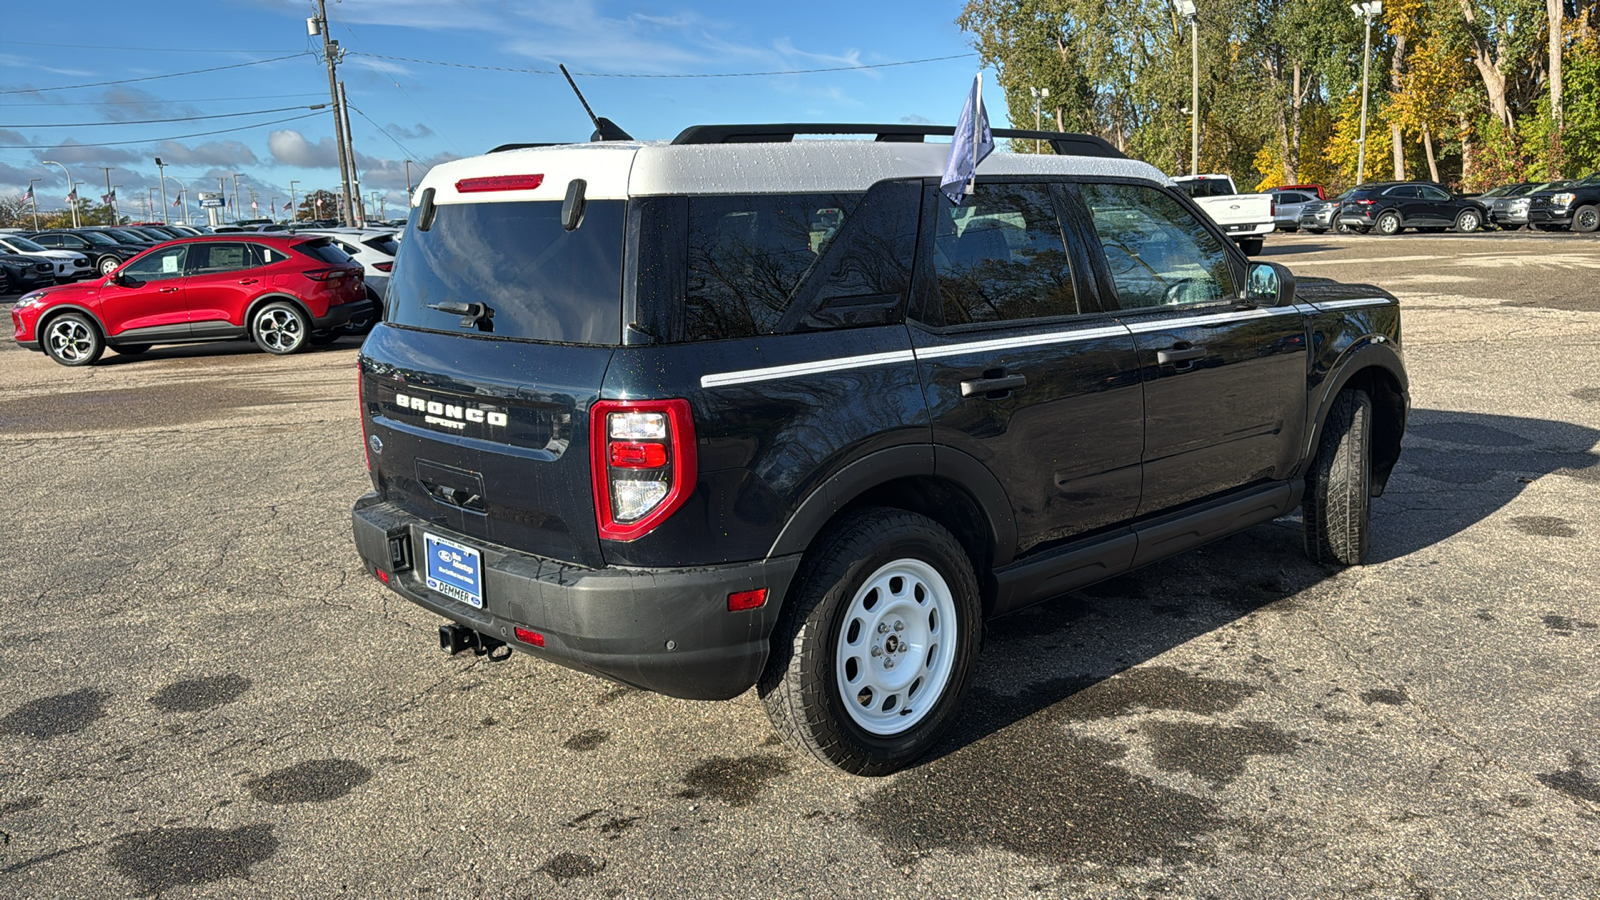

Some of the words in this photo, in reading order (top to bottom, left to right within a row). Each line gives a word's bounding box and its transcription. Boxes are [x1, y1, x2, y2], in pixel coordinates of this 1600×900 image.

[396, 394, 507, 427] BRONCO
[425, 415, 466, 429] SPORT
[438, 582, 470, 602] DEMMER
